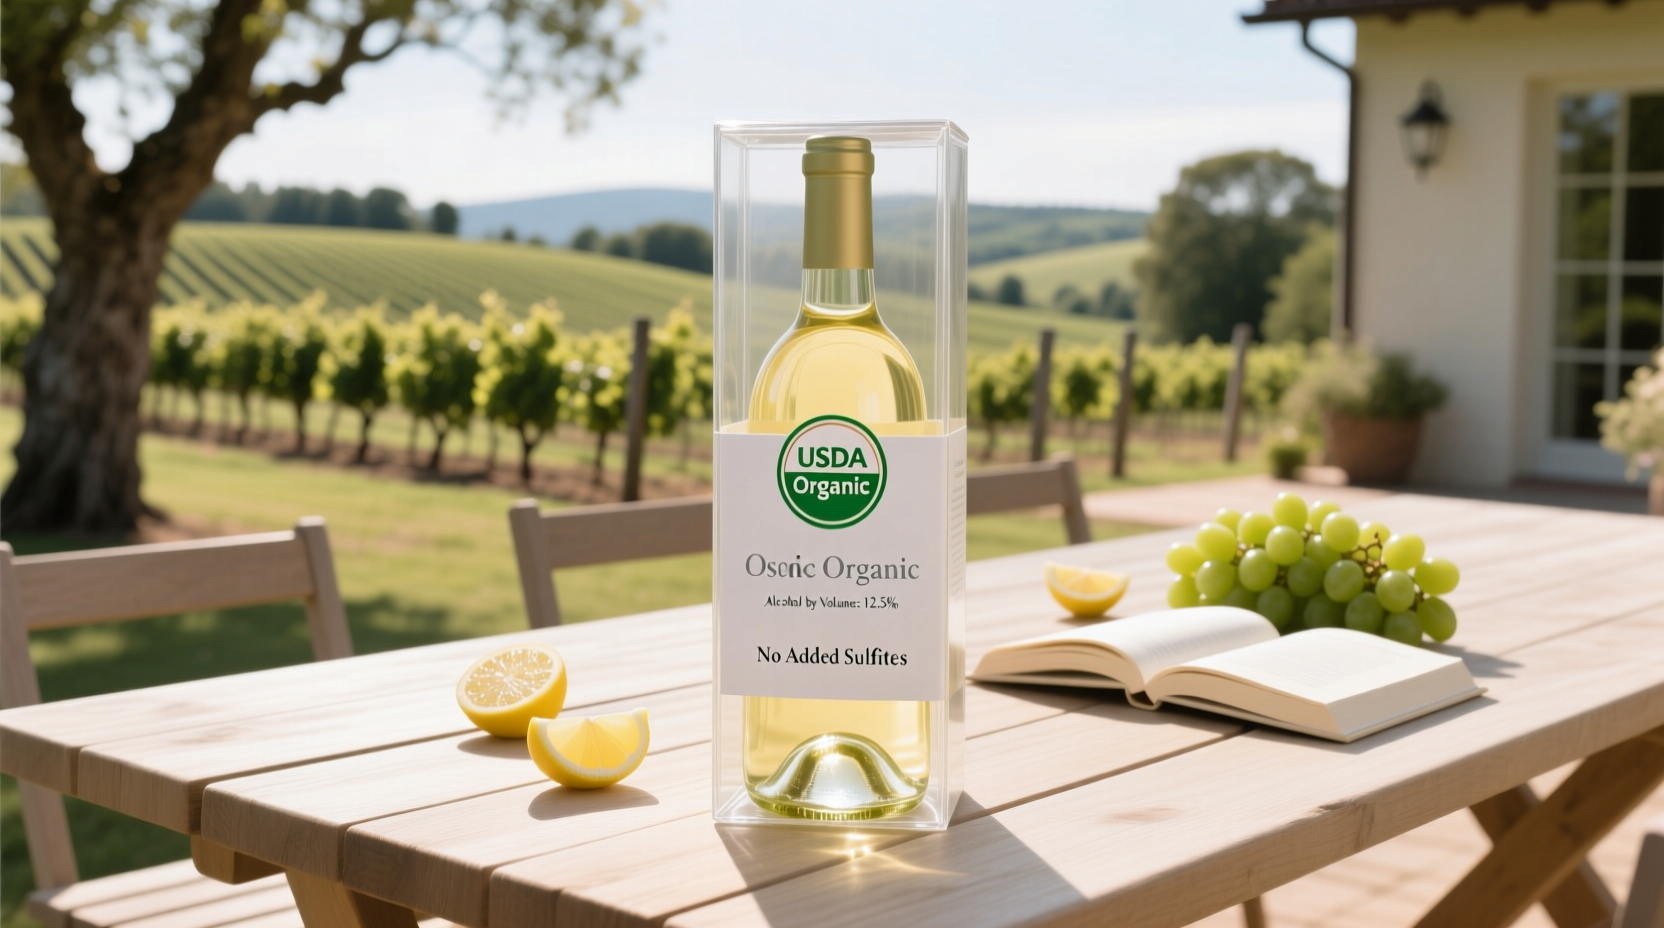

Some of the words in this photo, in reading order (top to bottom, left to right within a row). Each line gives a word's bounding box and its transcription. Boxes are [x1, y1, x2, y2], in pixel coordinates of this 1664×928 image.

[798, 446, 868, 468] USDA
[793, 475, 870, 501] Organic
[822, 555, 920, 586] Organic
[805, 595, 817, 611] by
[864, 596, 899, 609] 12.5%
[757, 646, 781, 663] No
[785, 646, 839, 665] Added
[844, 647, 908, 666] Sulfites
